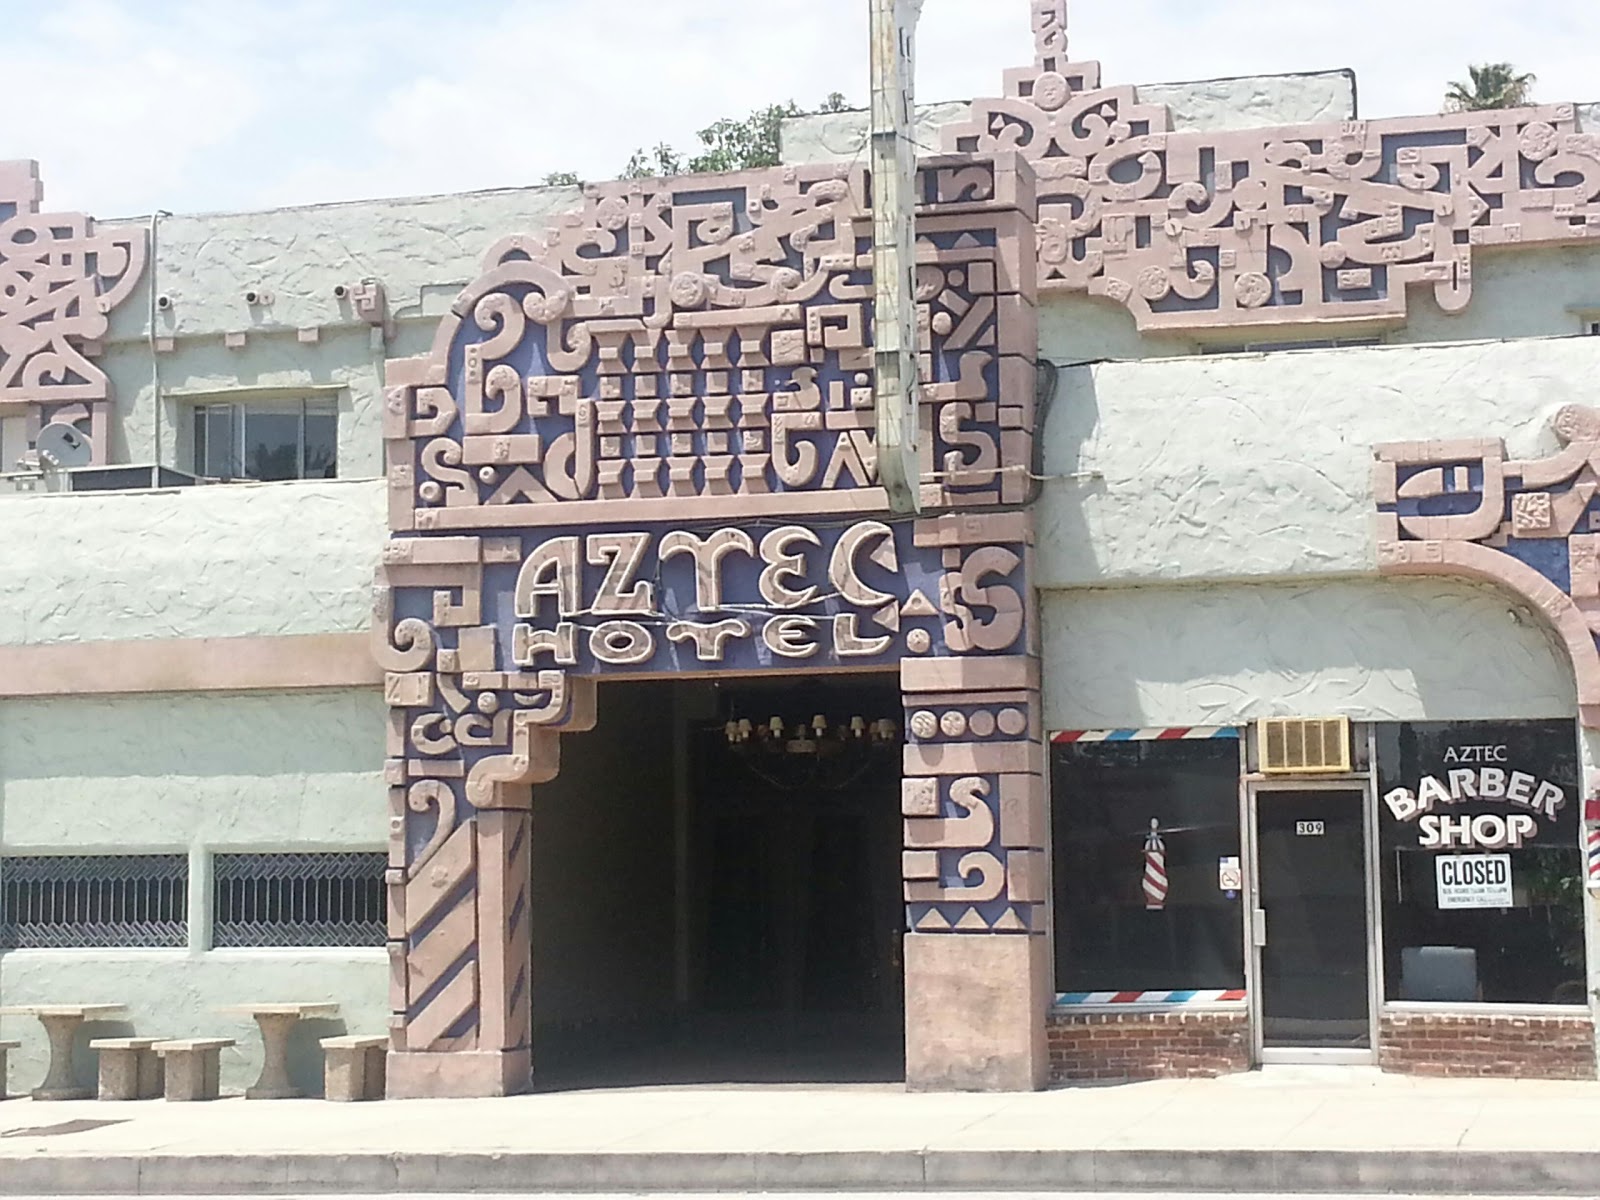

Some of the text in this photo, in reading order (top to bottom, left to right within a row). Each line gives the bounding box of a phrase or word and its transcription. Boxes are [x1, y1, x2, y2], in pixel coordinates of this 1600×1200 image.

[514, 519, 898, 618] AZTEC
[511, 613, 893, 666] HOTEL
[1442, 744, 1508, 763] AZTEC
[1383, 766, 1565, 821] BARBER
[1298, 822, 1322, 834] 309
[1418, 814, 1535, 847] SHOP
[1441, 859, 1506, 886] CLOSED
